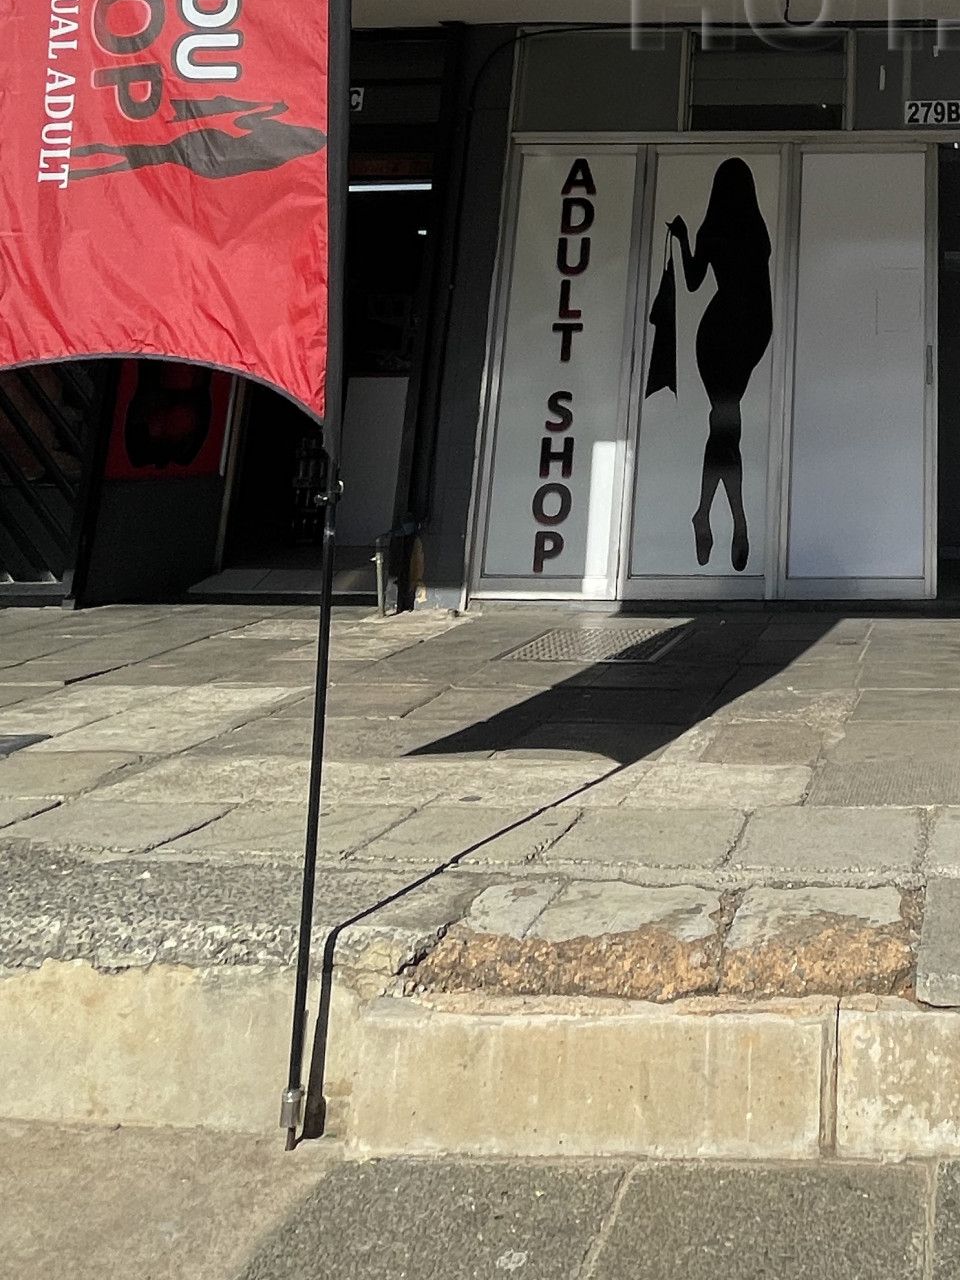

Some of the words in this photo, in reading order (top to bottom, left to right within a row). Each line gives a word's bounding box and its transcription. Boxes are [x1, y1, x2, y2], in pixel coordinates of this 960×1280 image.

[37, 67, 76, 189] ADULT
[907, 101, 960, 123] 279B
[551, 158, 597, 362] ADULT
[532, 391, 575, 573] SHOP
